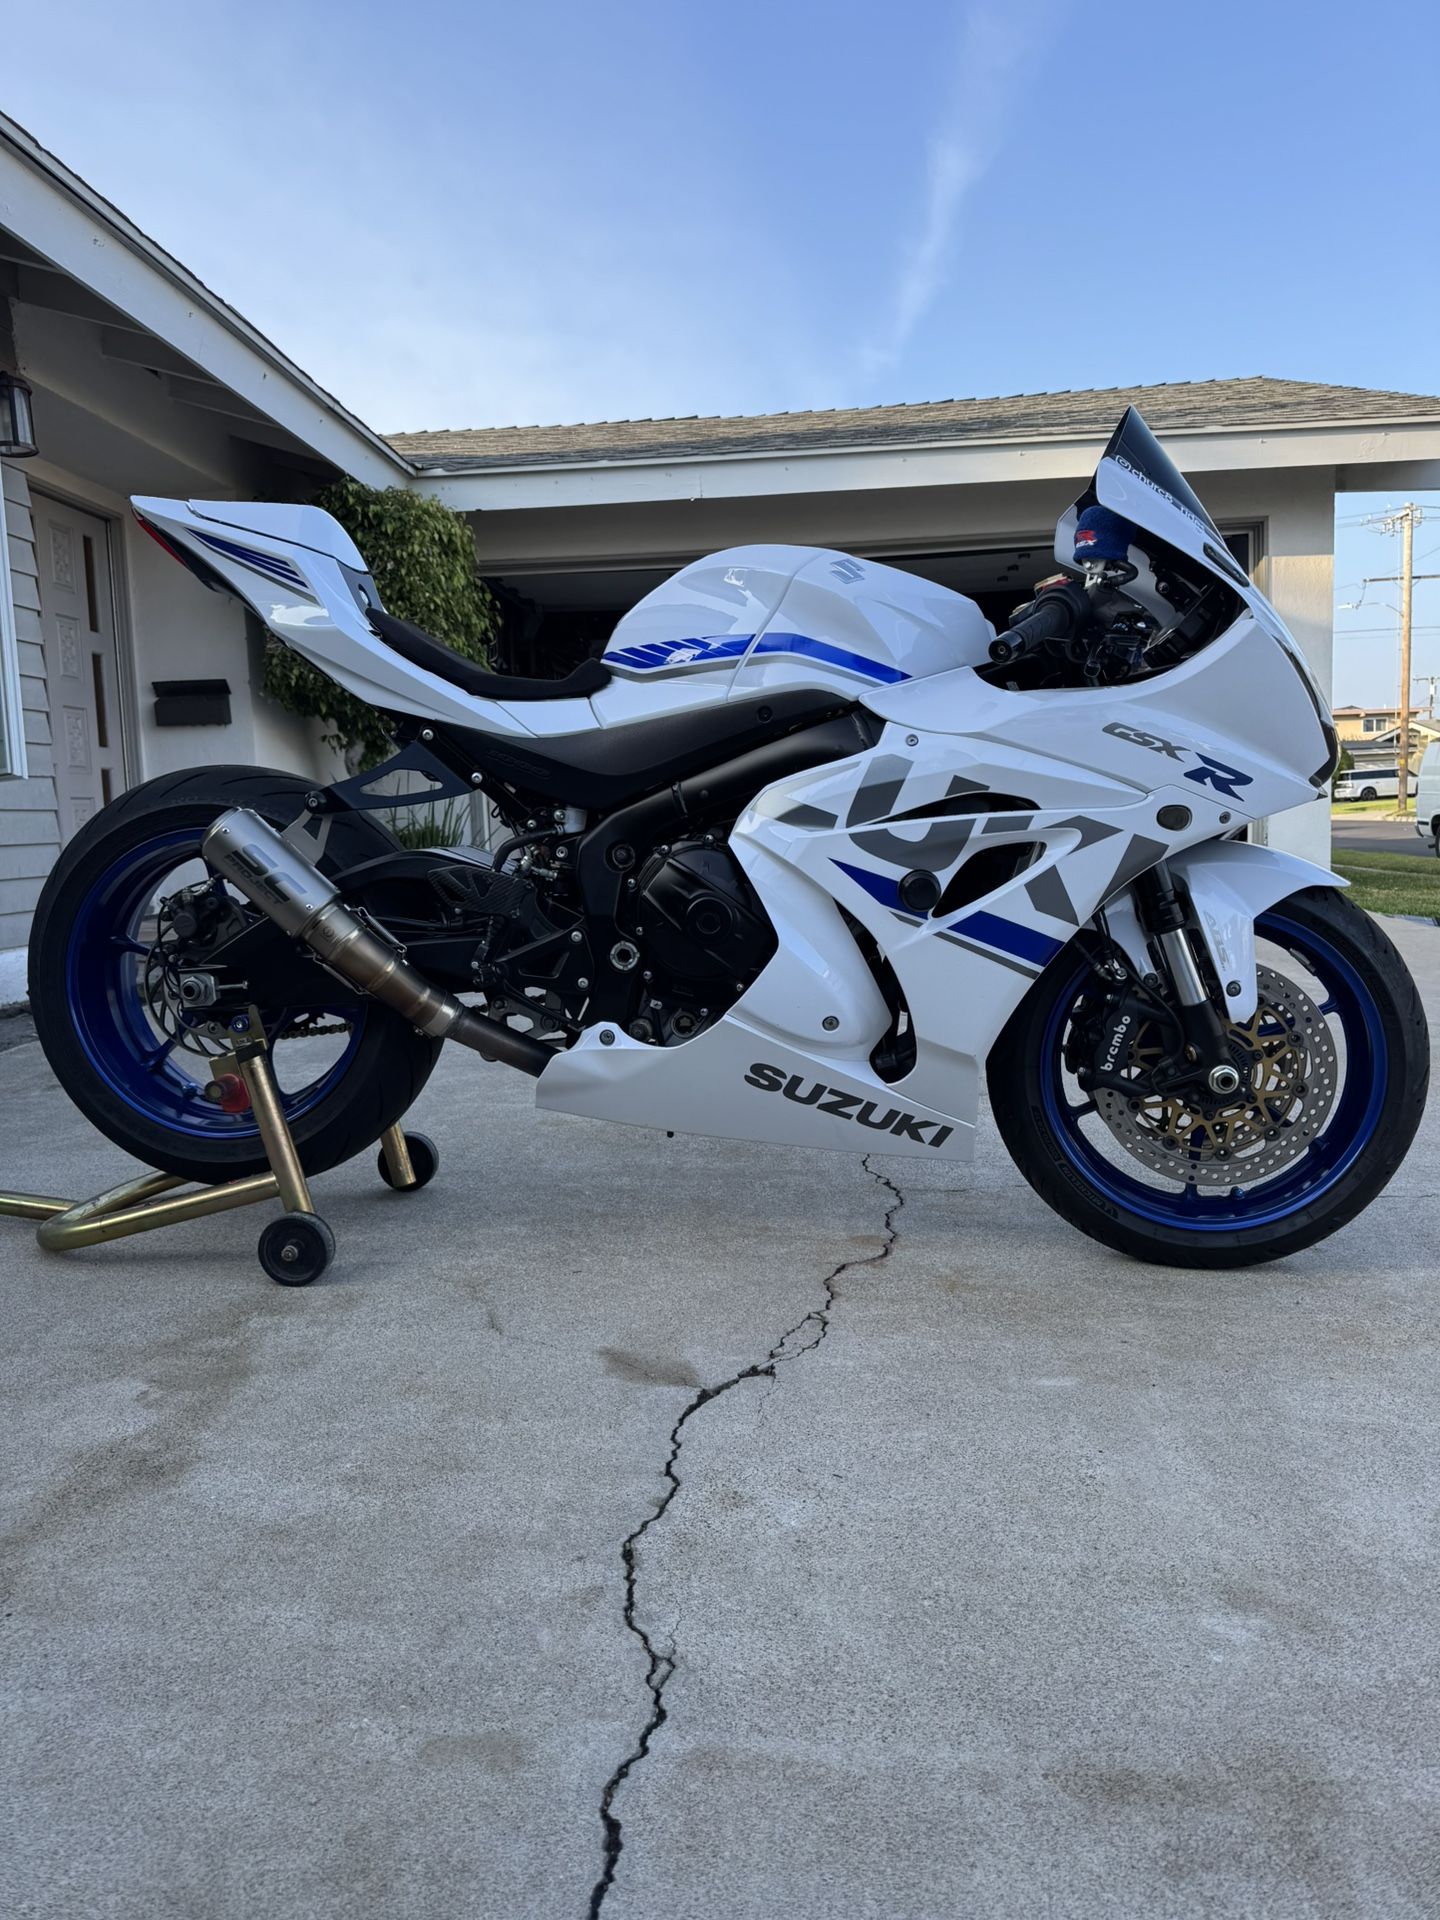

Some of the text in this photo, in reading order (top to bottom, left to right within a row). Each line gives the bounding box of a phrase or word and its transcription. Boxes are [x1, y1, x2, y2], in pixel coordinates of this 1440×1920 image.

[223, 853, 285, 905] PROJECT
[232, 843, 308, 902] SC
[1100, 1015, 1132, 1072] brembo
[744, 1062, 954, 1148] SUZUKI
